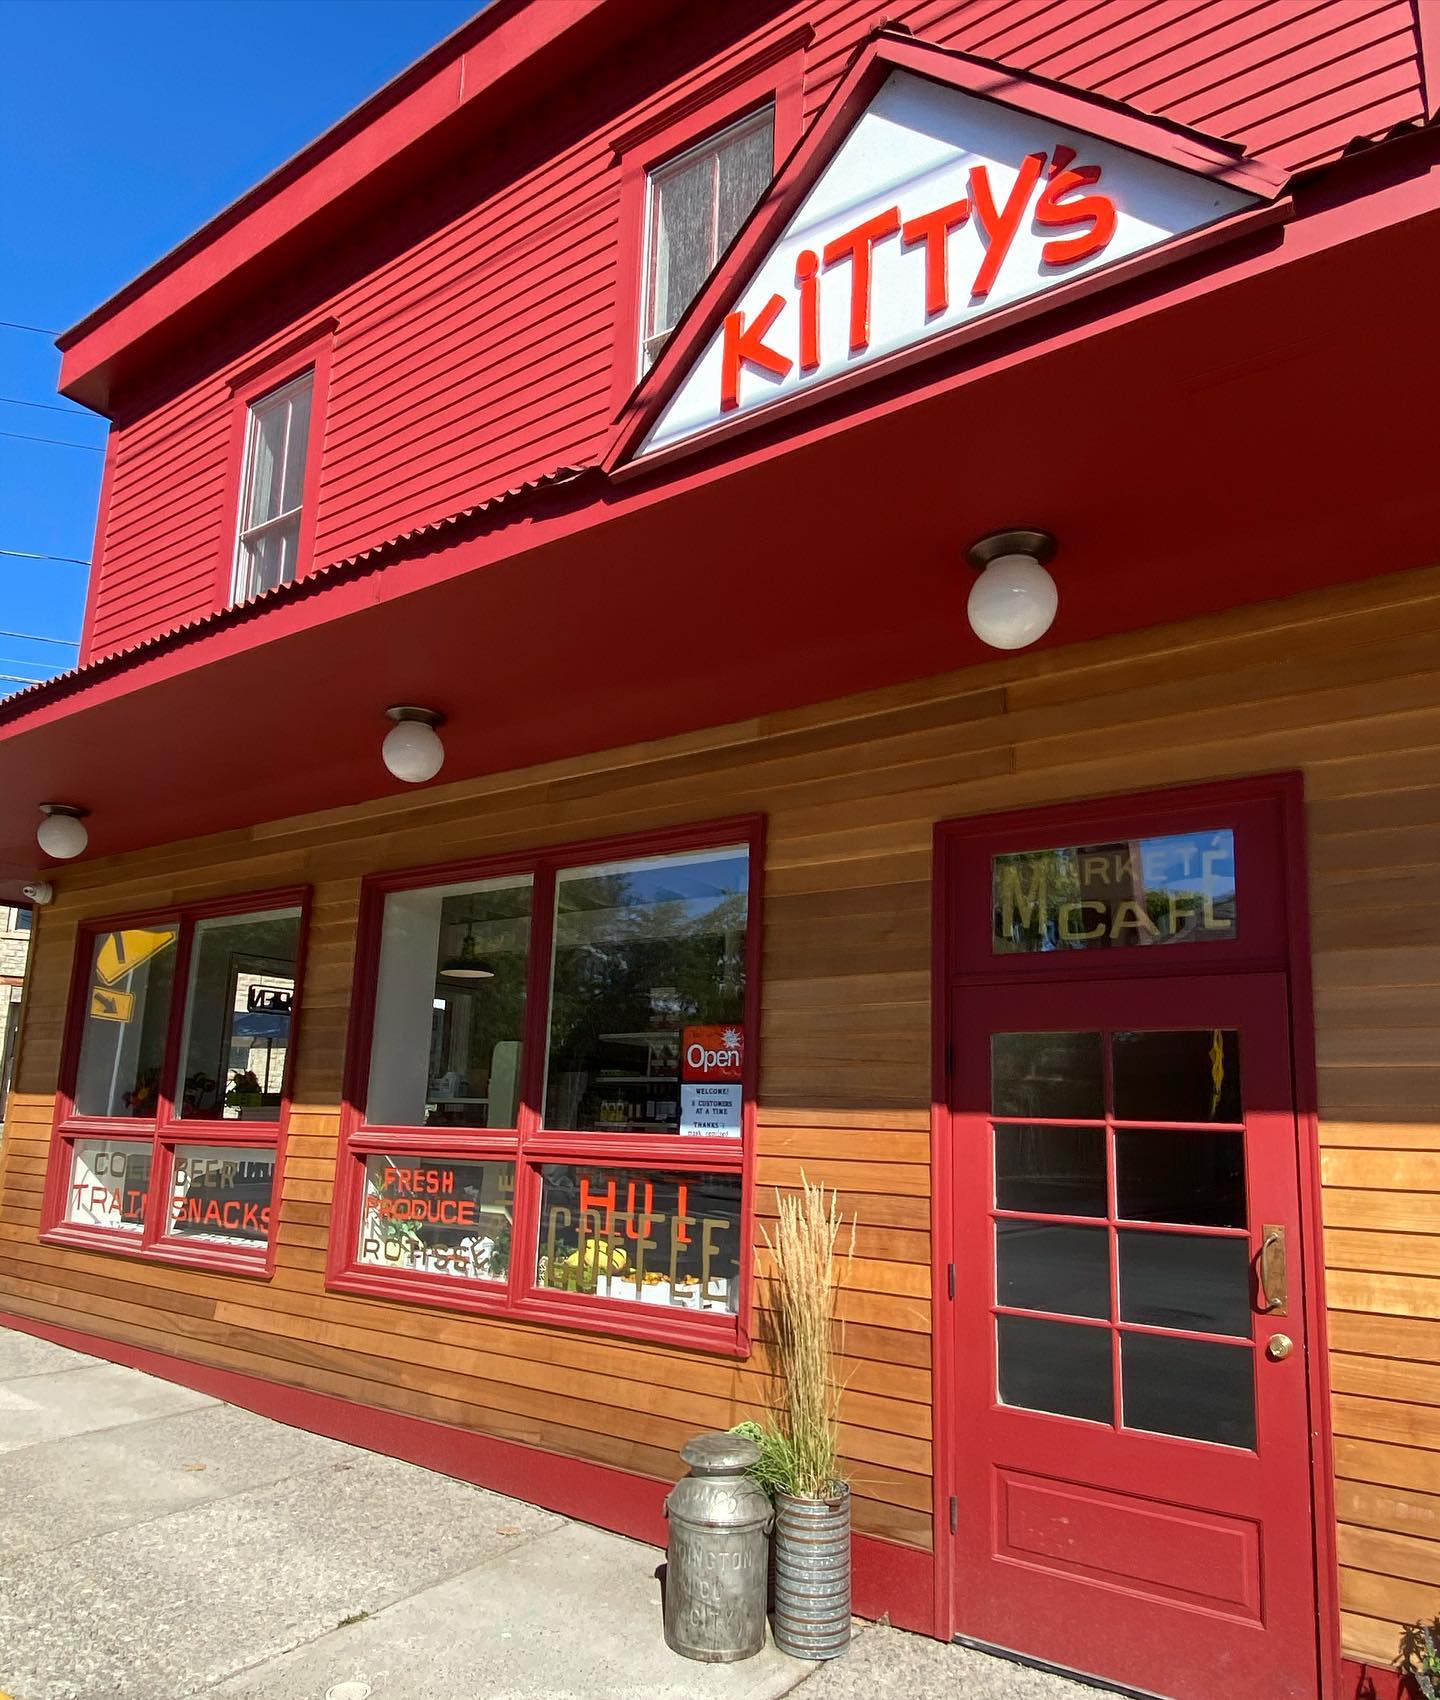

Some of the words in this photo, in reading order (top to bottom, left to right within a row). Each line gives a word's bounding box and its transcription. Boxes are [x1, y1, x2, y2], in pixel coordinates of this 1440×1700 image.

[687, 1044, 739, 1072] Open
[693, 1121, 719, 1129] THANKS
[173, 1157, 237, 1189] BEER
[384, 1167, 455, 1194] FRESH
[172, 1196, 271, 1234] SNACKS
[365, 1195, 476, 1226] PRODUCE
[547, 1206, 730, 1303] COFFEE
